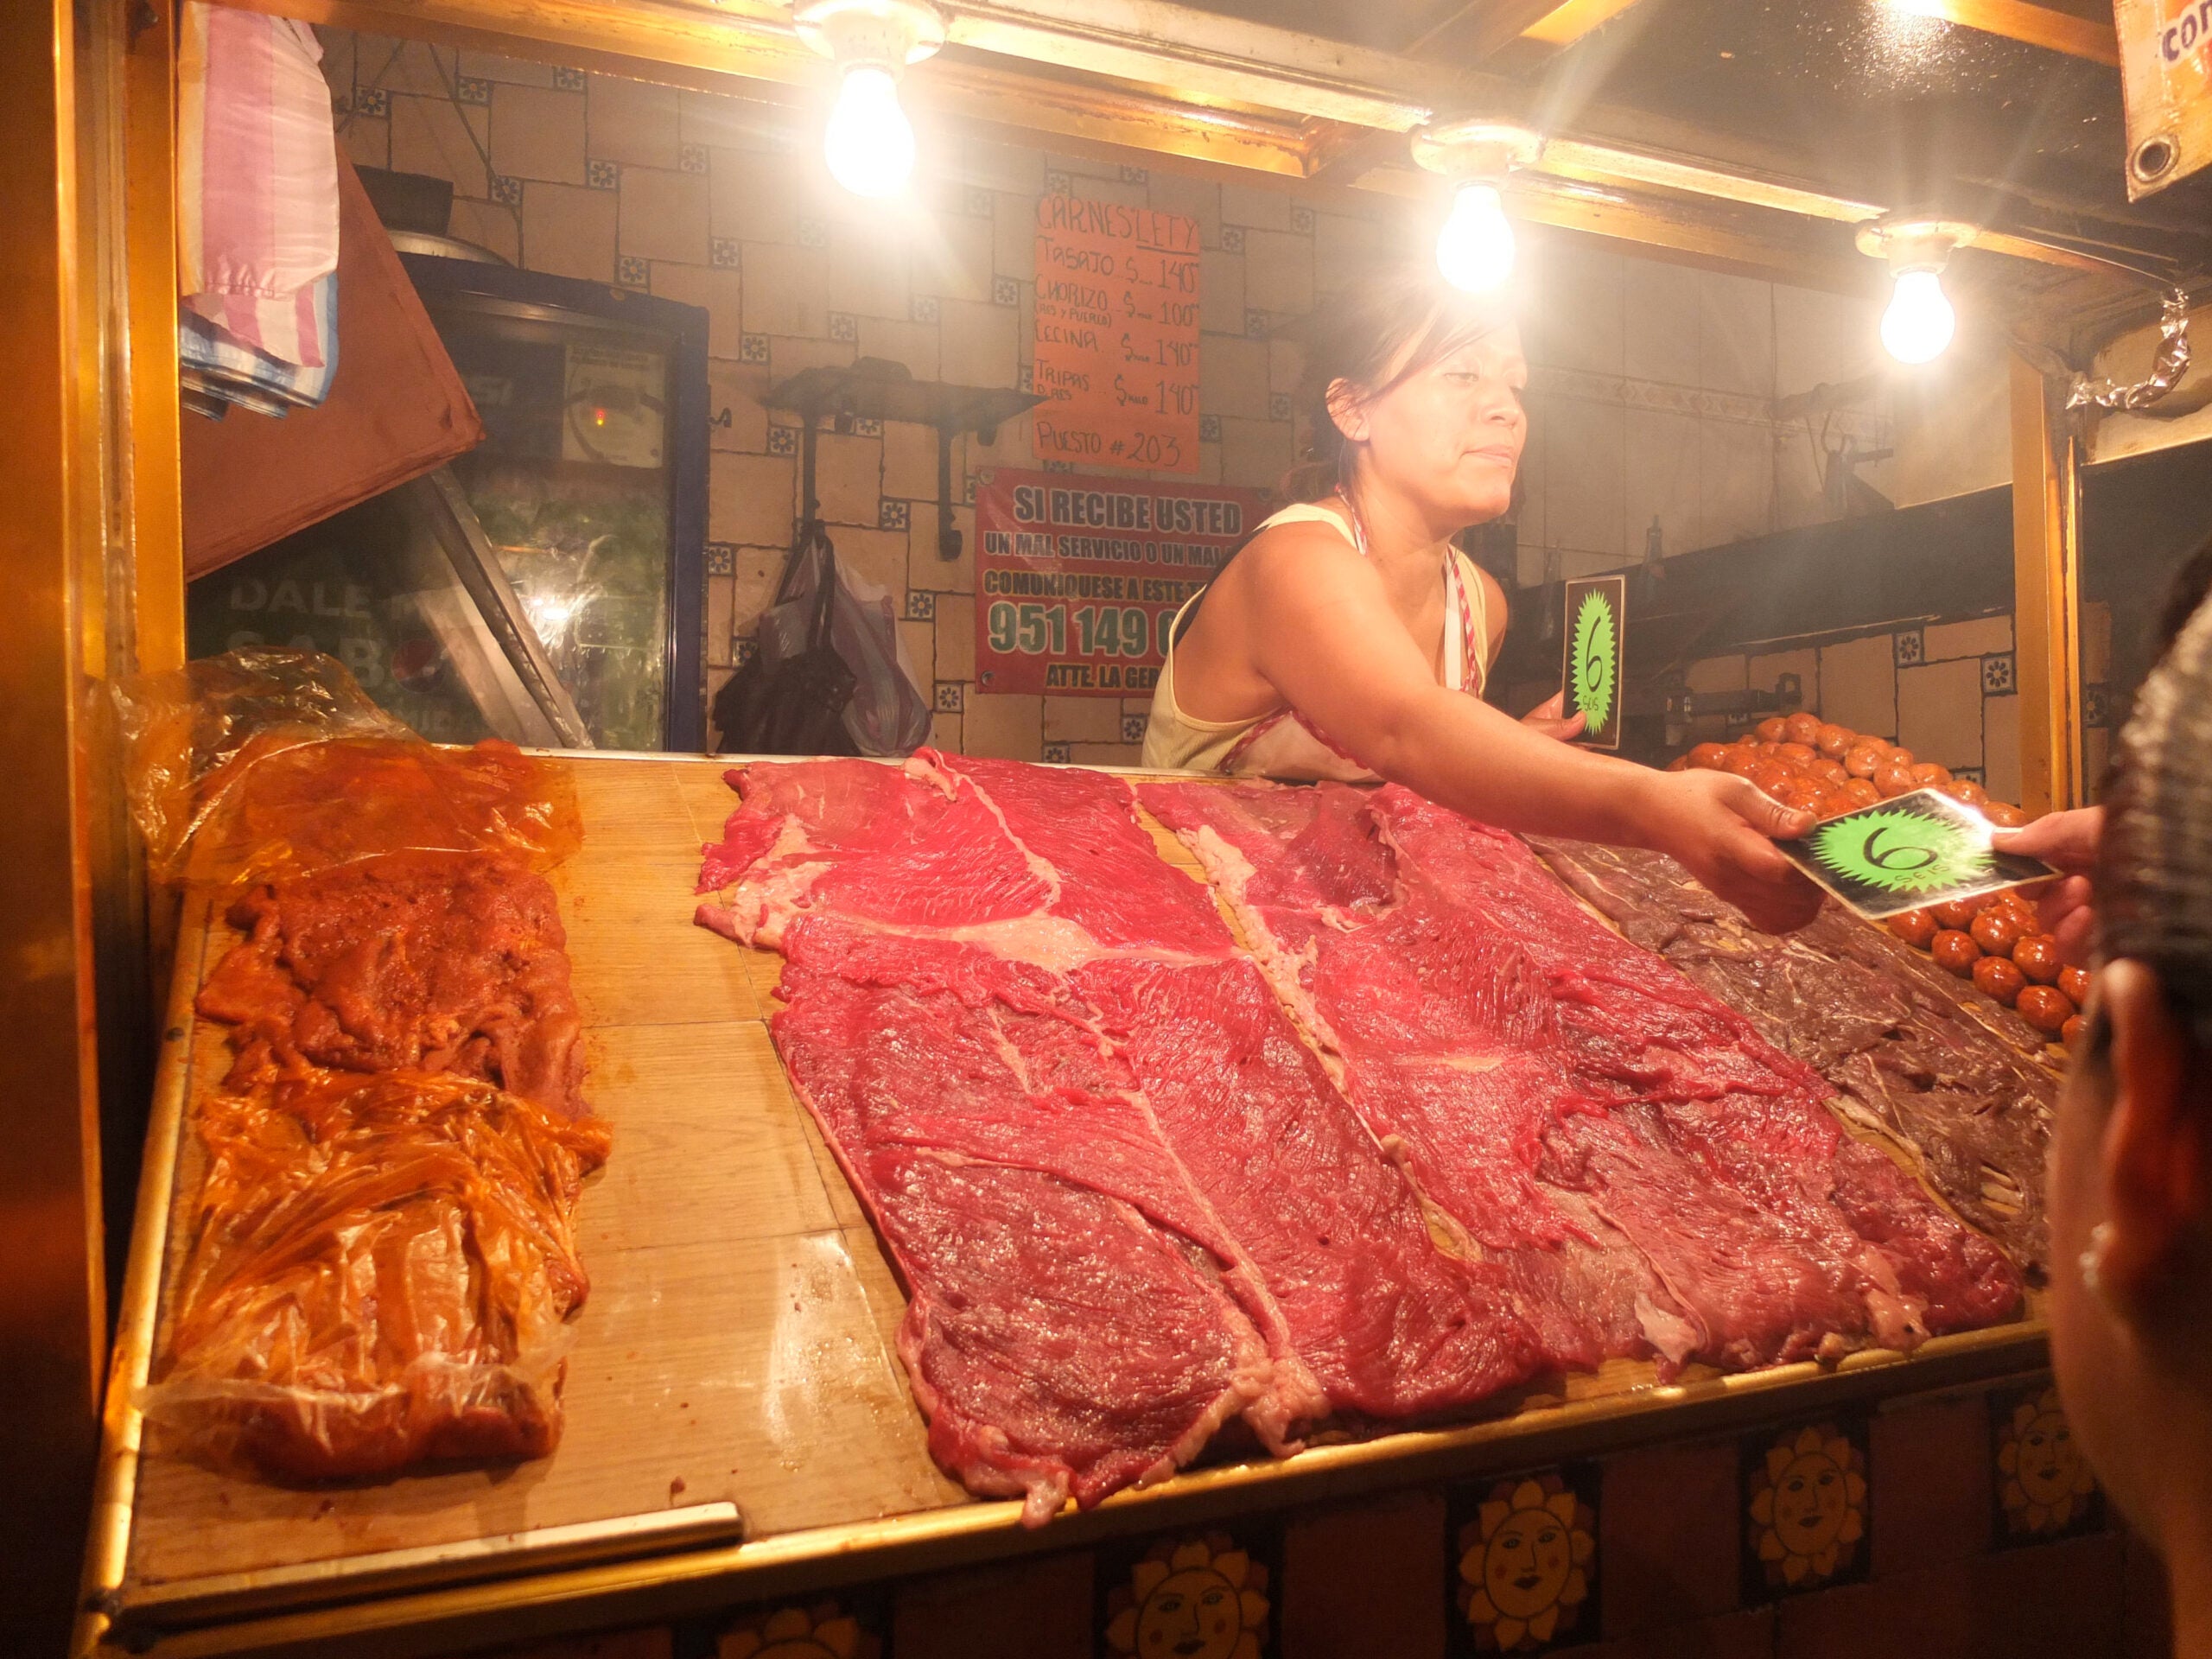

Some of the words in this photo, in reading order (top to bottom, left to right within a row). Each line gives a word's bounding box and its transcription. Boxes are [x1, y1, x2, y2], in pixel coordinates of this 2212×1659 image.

[1037, 195, 1132, 239] CARNES
[1036, 234, 1115, 276] TASAJO
[1033, 272, 1108, 312] CHORIZO
[1033, 319, 1099, 353] CECINA
[1036, 358, 1090, 392] TRIPAS
[1036, 420, 1102, 455] PUESTO
[1126, 430, 1182, 467] 203
[1014, 485, 1046, 524] SI
[1049, 488, 1152, 532] RECIBE
[1154, 496, 1243, 537] USTED
[983, 531, 1012, 556] UN
[1014, 532, 1056, 557] MAL
[1058, 534, 1142, 563] SERVICIO
[1144, 540, 1159, 564] O
[1160, 542, 1185, 567] UN
[229, 577, 372, 620] DALE
[982, 568, 1124, 601] COMUNIQUESE
[1126, 575, 1141, 601] A
[1141, 576, 1185, 603] ESTE
[988, 600, 1066, 654] 951
[1071, 605, 1149, 658] 149
[1586, 614, 1603, 693] 6
[1097, 664, 1122, 689] LA
[1863, 826, 1939, 871] 6
